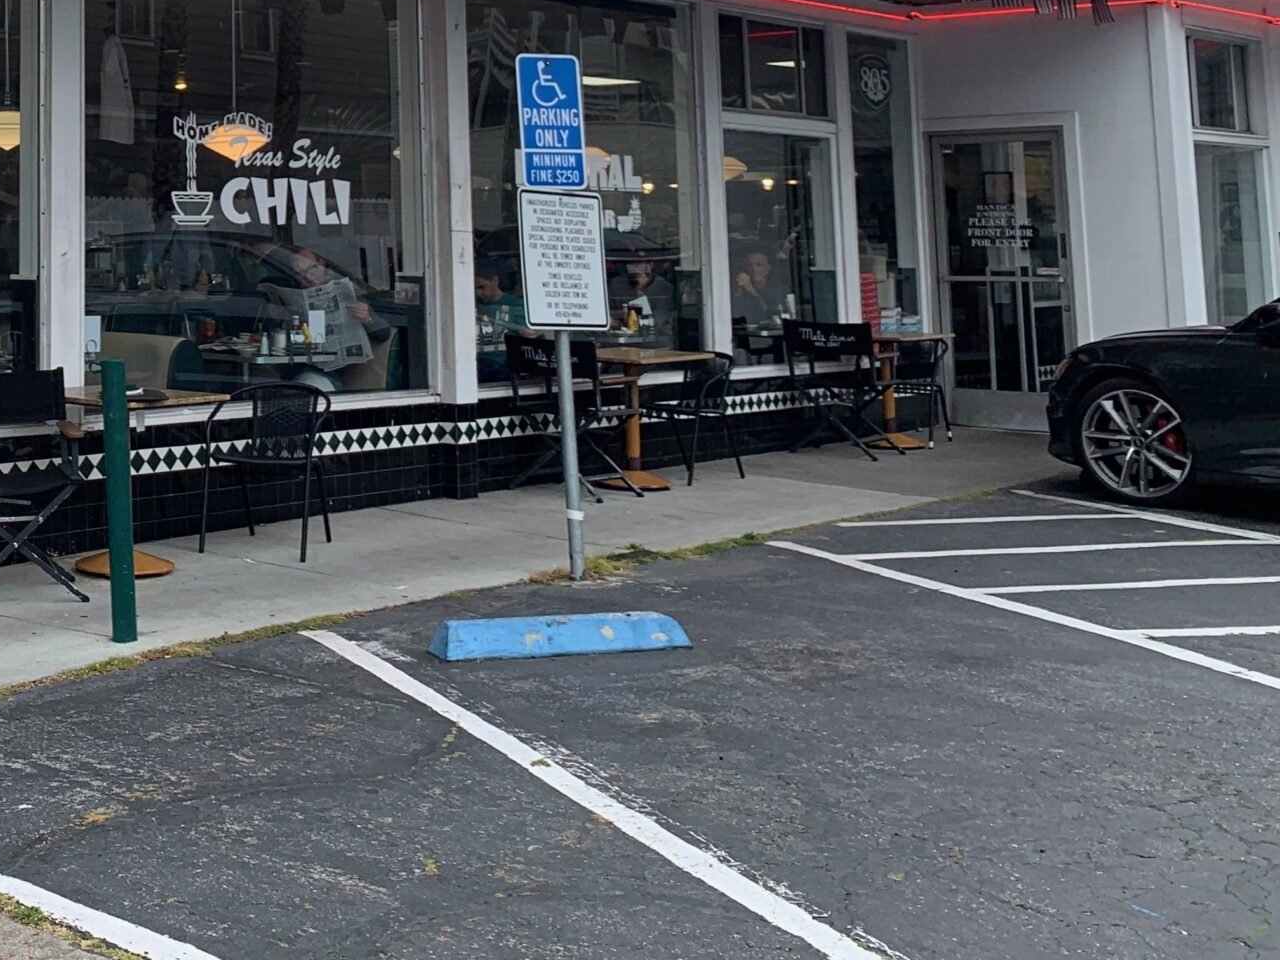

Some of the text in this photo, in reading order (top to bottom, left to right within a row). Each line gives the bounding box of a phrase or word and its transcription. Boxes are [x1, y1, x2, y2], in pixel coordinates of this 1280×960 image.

[860, 66, 889, 94] 805
[523, 107, 579, 127] PARKING
[223, 112, 272, 142] MADE!
[535, 129, 569, 148] ONLY
[229, 135, 341, 176] Texas Style
[532, 153, 576, 168] MINIMUM
[530, 169, 580, 185] FINE $250
[220, 176, 351, 226] CHILI
[968, 217, 1008, 227] PLEASE
[967, 227, 1034, 237] FRONT DOOR
[971, 238, 1031, 248] FOR ENTRY
